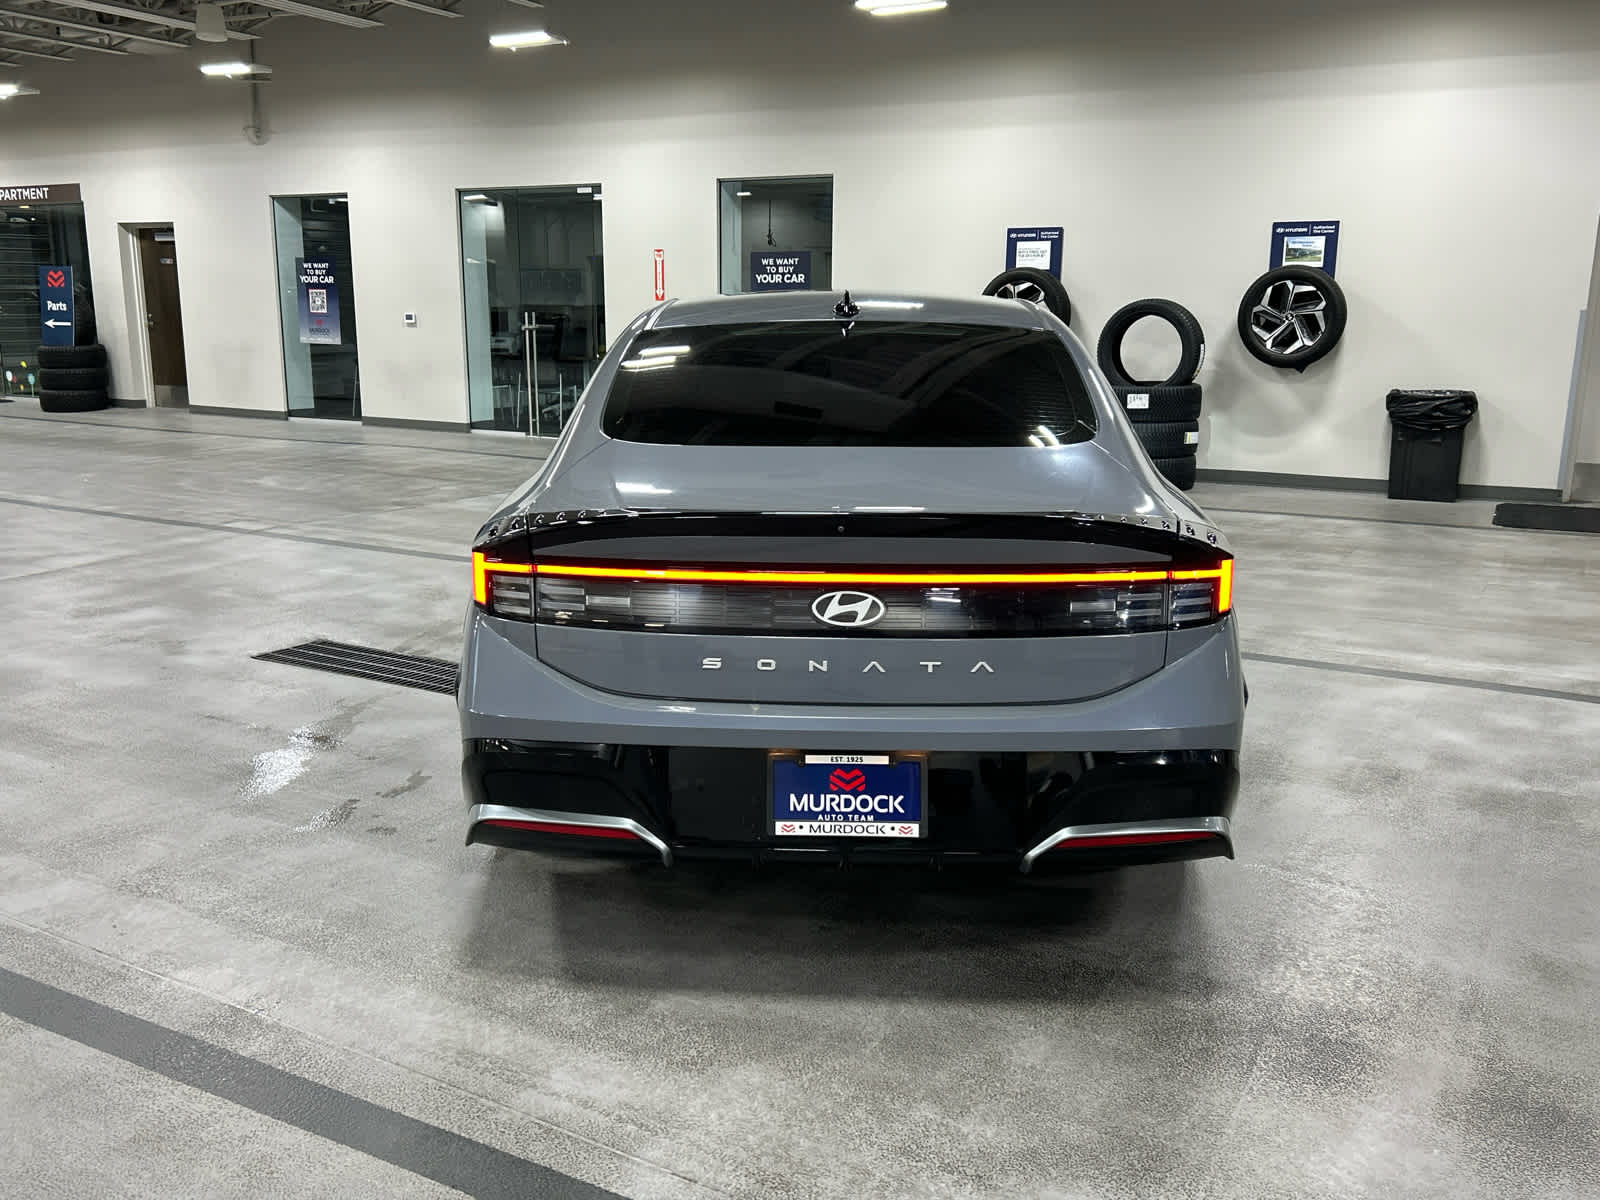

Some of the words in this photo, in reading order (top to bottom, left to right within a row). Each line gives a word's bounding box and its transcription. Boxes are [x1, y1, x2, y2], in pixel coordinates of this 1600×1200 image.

[755, 274, 782, 283] YOUR
[784, 274, 805, 283] CAR
[47, 300, 67, 311] Parts
[702, 657, 995, 673] SONATA
[789, 793, 905, 813] MURDOCK
[817, 814, 844, 822] AUTO
[847, 814, 874, 822] TEAM
[808, 823, 886, 835] MURDOCK
